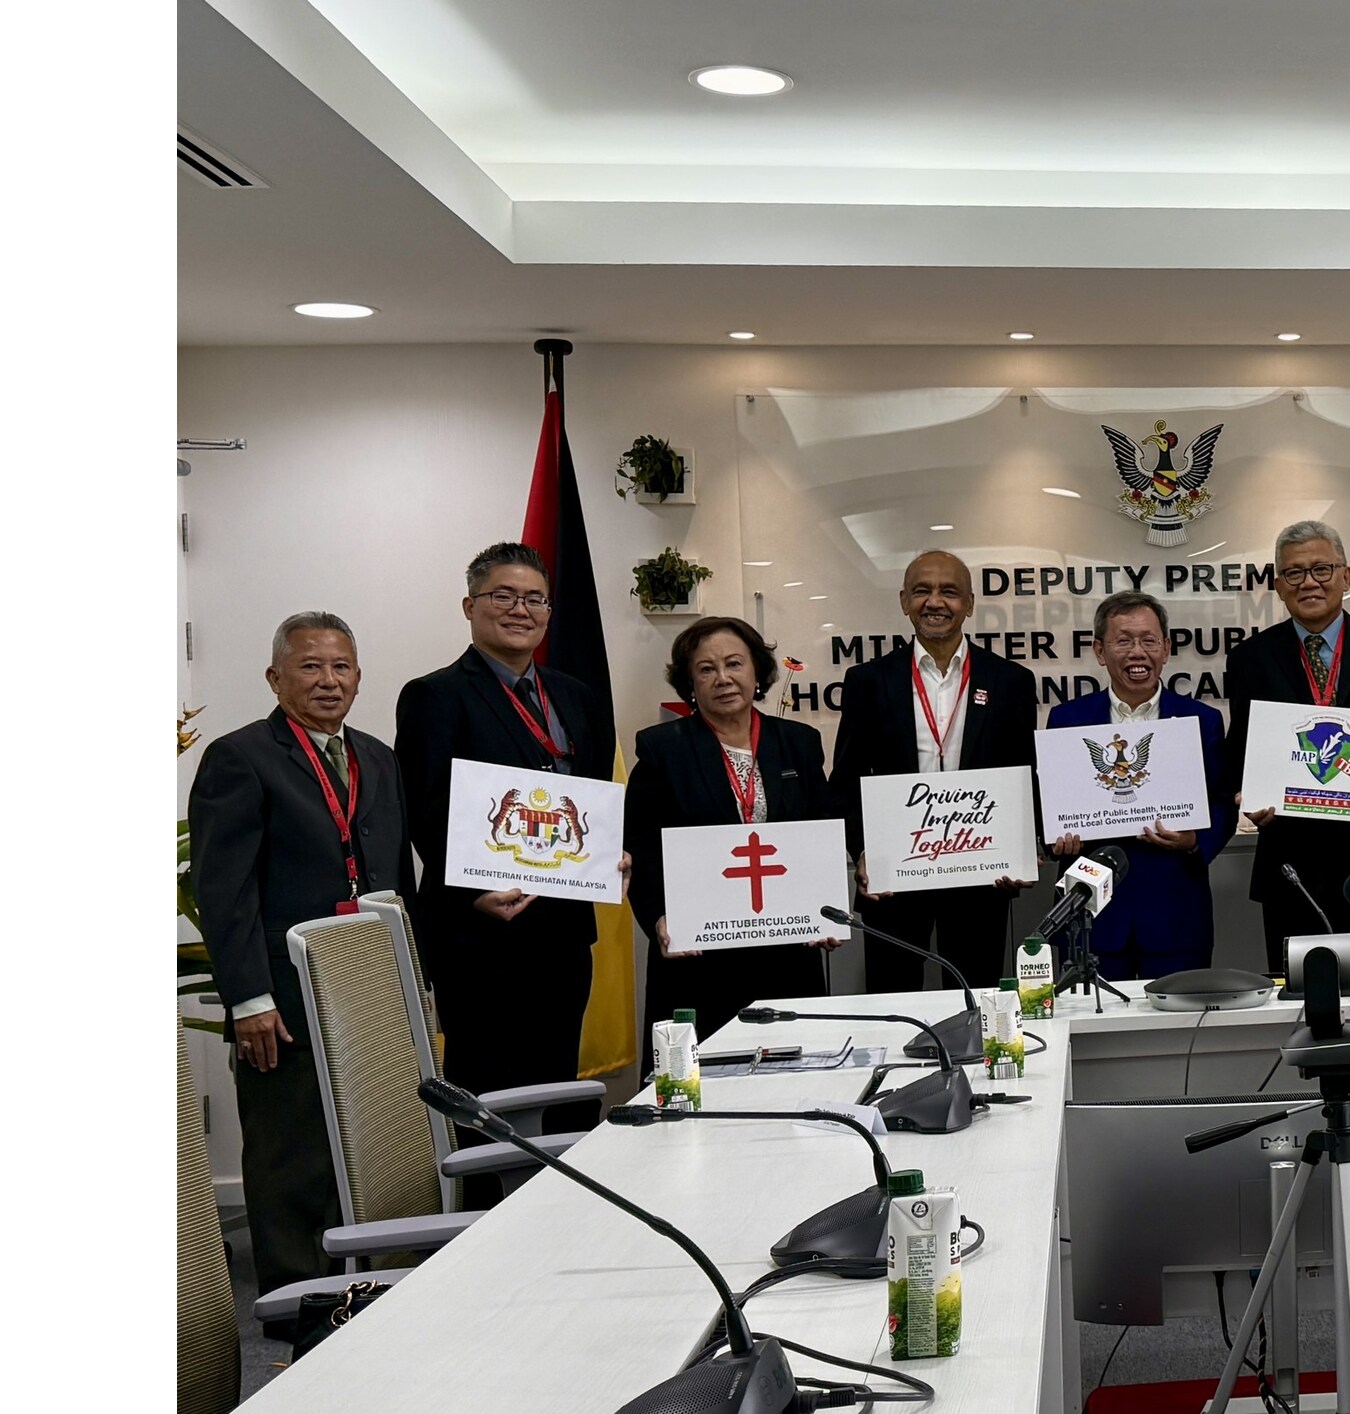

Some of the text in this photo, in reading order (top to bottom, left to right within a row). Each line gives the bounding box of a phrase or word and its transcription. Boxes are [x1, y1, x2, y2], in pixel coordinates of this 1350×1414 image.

[982, 563, 1275, 596] DEPUTY PREM
[1036, 673, 1100, 704] ND
[1291, 751, 1316, 763] MAP
[905, 782, 989, 810] Driving
[920, 800, 999, 842] Impact
[1057, 802, 1194, 822] Ministry of Public Health, Housing
[1063, 810, 1191, 829] and Local Government Sarawak
[909, 827, 993, 861] Together
[463, 866, 607, 890] KEMENTERIAN KESIHATAN MALAYSIA
[896, 862, 1010, 878] Through Business Events
[704, 915, 811, 930] ANTI TUBERCULOSIS
[695, 925, 820, 942] ASSOCIATION SARAWAK
[1020, 963, 1050, 971] BORNEO
